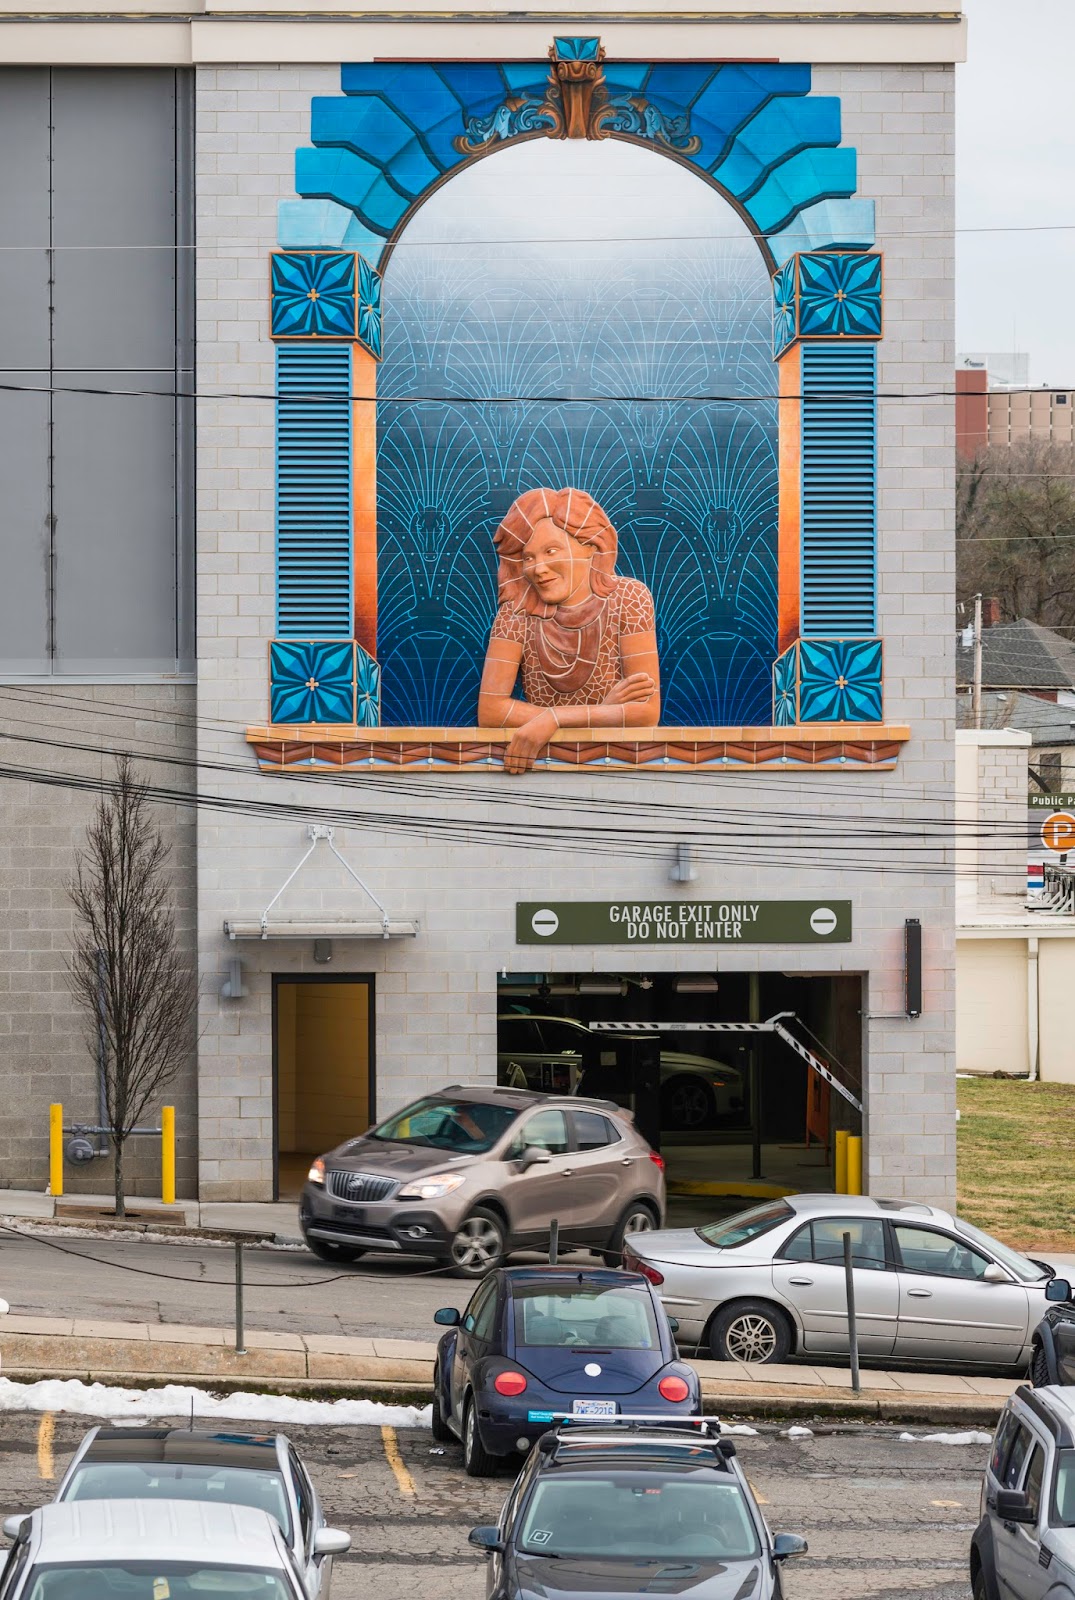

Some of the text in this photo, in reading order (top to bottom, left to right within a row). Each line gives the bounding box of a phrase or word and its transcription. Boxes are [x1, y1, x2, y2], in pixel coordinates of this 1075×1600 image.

[1032, 796, 1063, 805] Public
[1053, 821, 1072, 846] P
[609, 904, 760, 922] GARAGE EXIT ONLY
[627, 921, 742, 938] DO NOT ENTER
